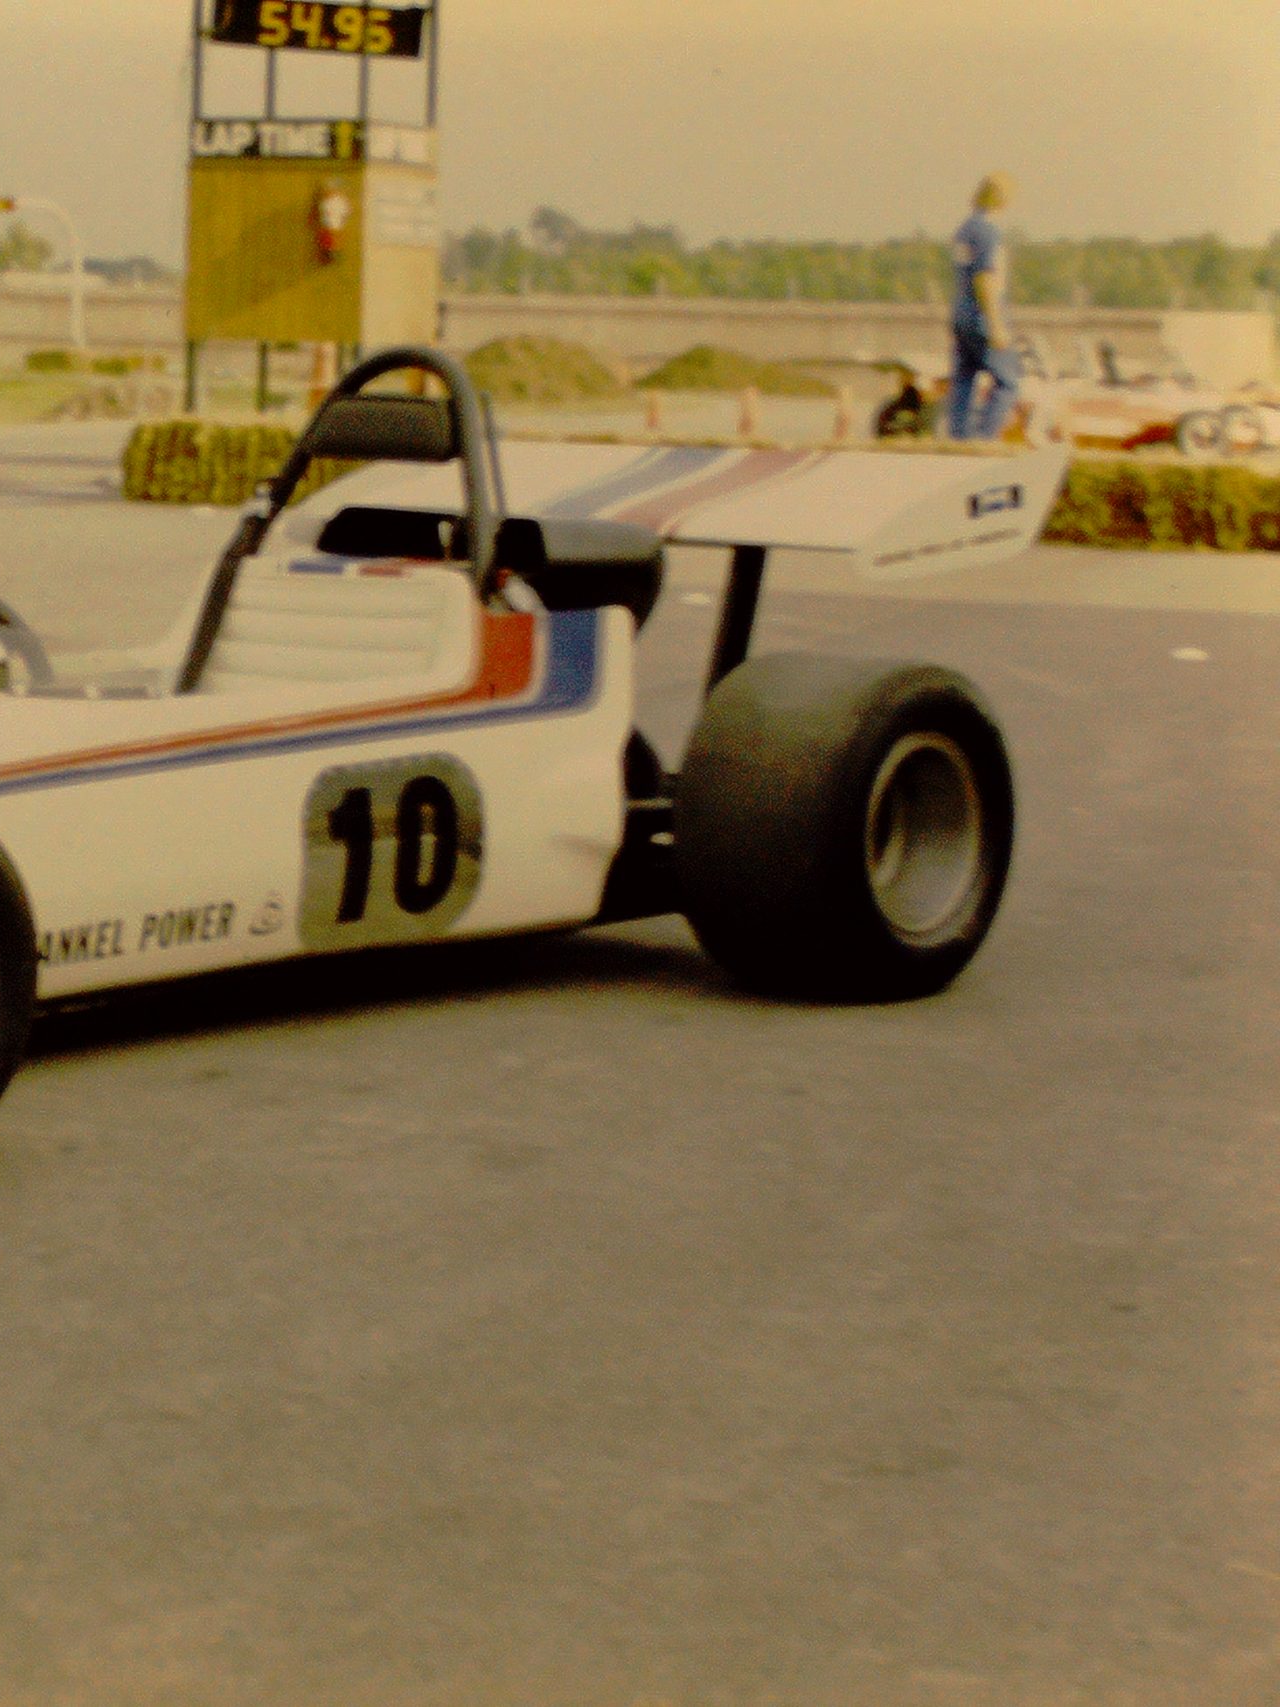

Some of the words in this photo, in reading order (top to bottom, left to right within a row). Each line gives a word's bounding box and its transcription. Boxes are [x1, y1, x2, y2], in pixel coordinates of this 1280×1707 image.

[193, 122, 253, 155] LAP
[327, 776, 458, 925] 10
[138, 901, 235, 952] POWER
